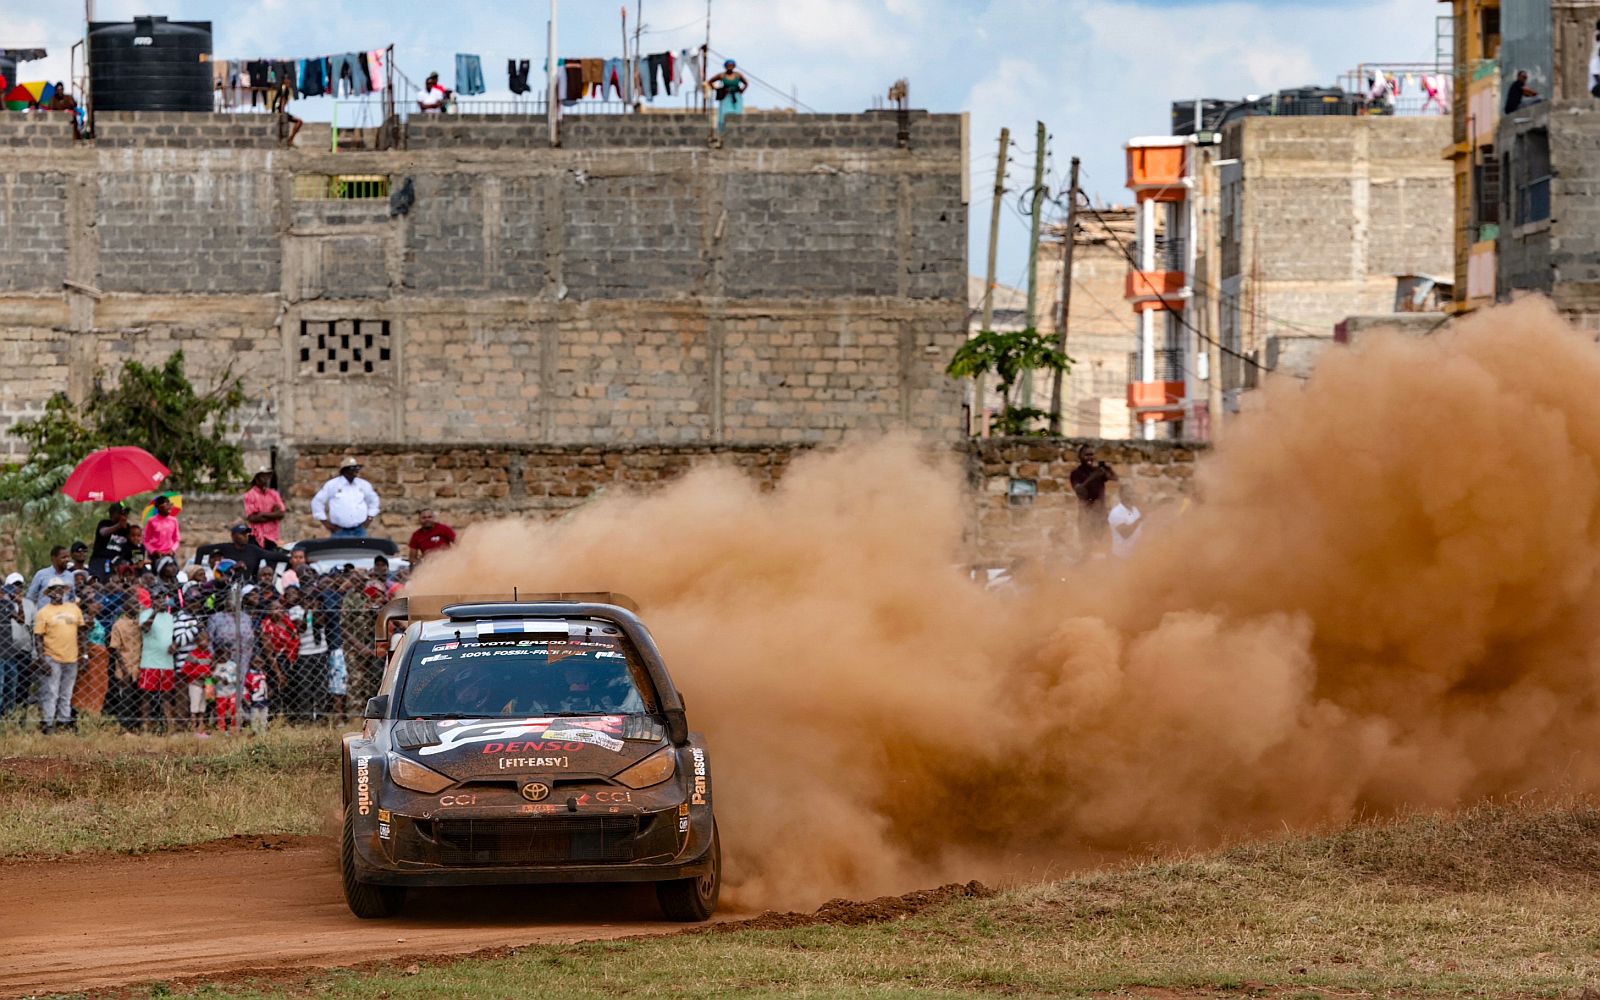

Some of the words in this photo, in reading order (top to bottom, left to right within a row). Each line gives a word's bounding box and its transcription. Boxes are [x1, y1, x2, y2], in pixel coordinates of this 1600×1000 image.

[569, 640, 615, 649] Racing
[482, 741, 586, 754] DENSO
[357, 755, 372, 816] Panasonic
